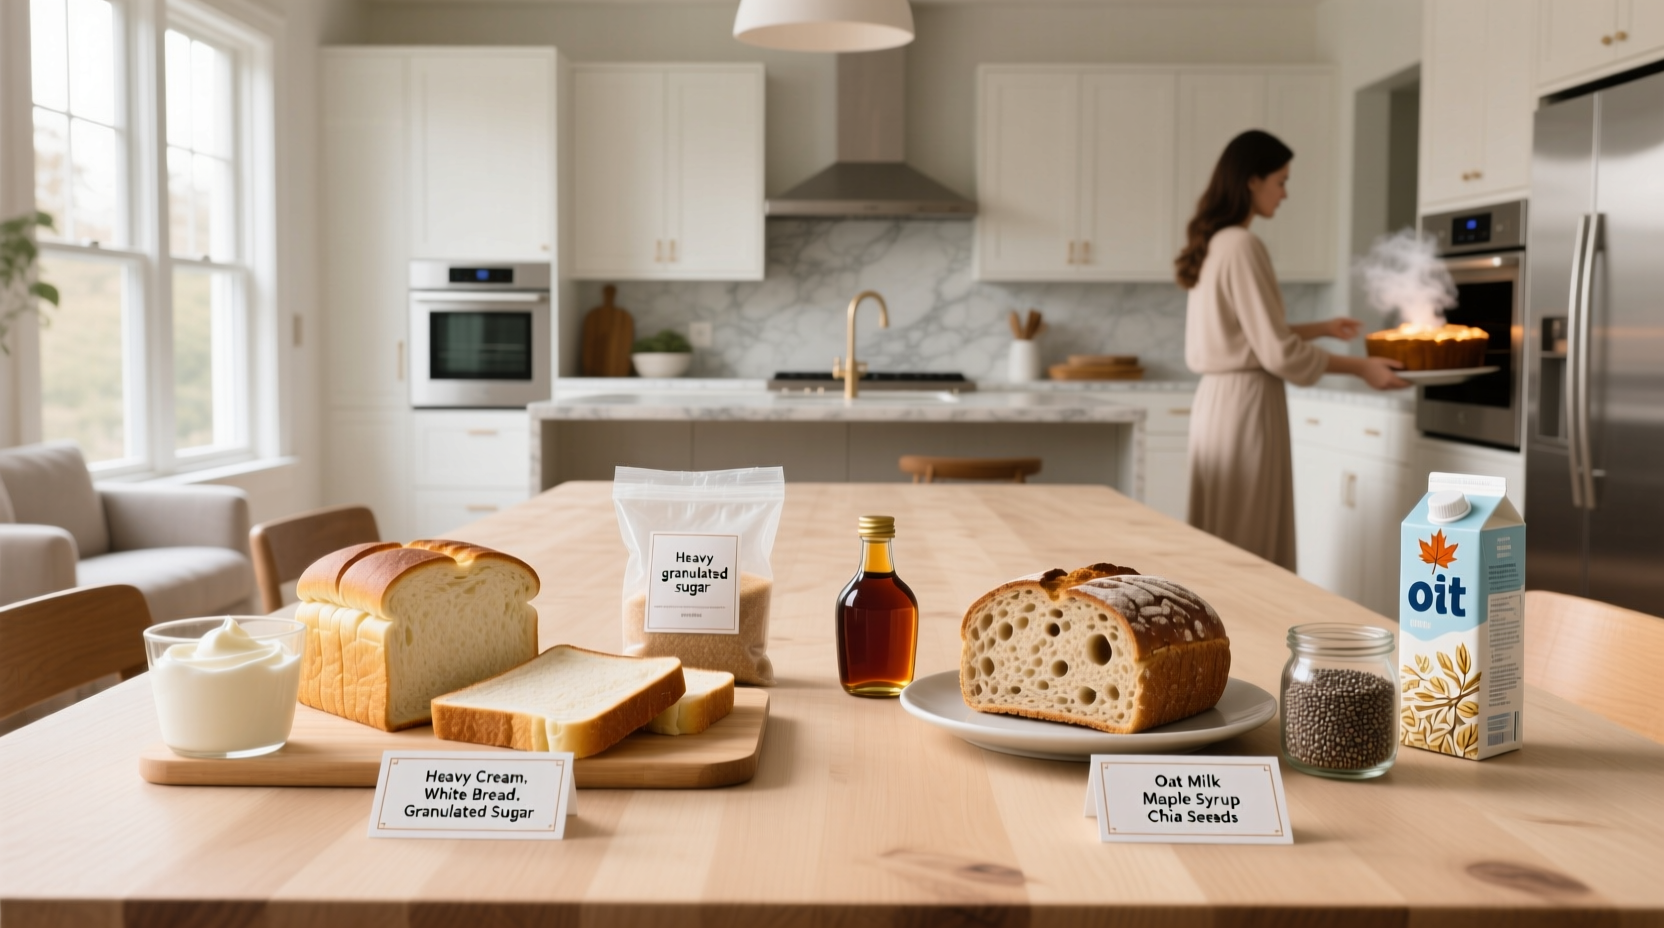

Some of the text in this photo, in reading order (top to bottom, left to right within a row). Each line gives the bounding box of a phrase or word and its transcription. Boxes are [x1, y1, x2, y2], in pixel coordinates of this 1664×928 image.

[676, 551, 714, 567] Heavy
[661, 566, 729, 582] granulated
[674, 583, 711, 597] sugar
[1408, 573, 1466, 617] oit
[425, 769, 528, 787] Heavy Cream,
[1154, 773, 1221, 788] Oat Milk
[424, 787, 468, 801] White
[1143, 791, 1241, 809] Maple Syrup
[404, 804, 535, 823] Granulated Sugar
[1147, 808, 1183, 823] Chia
